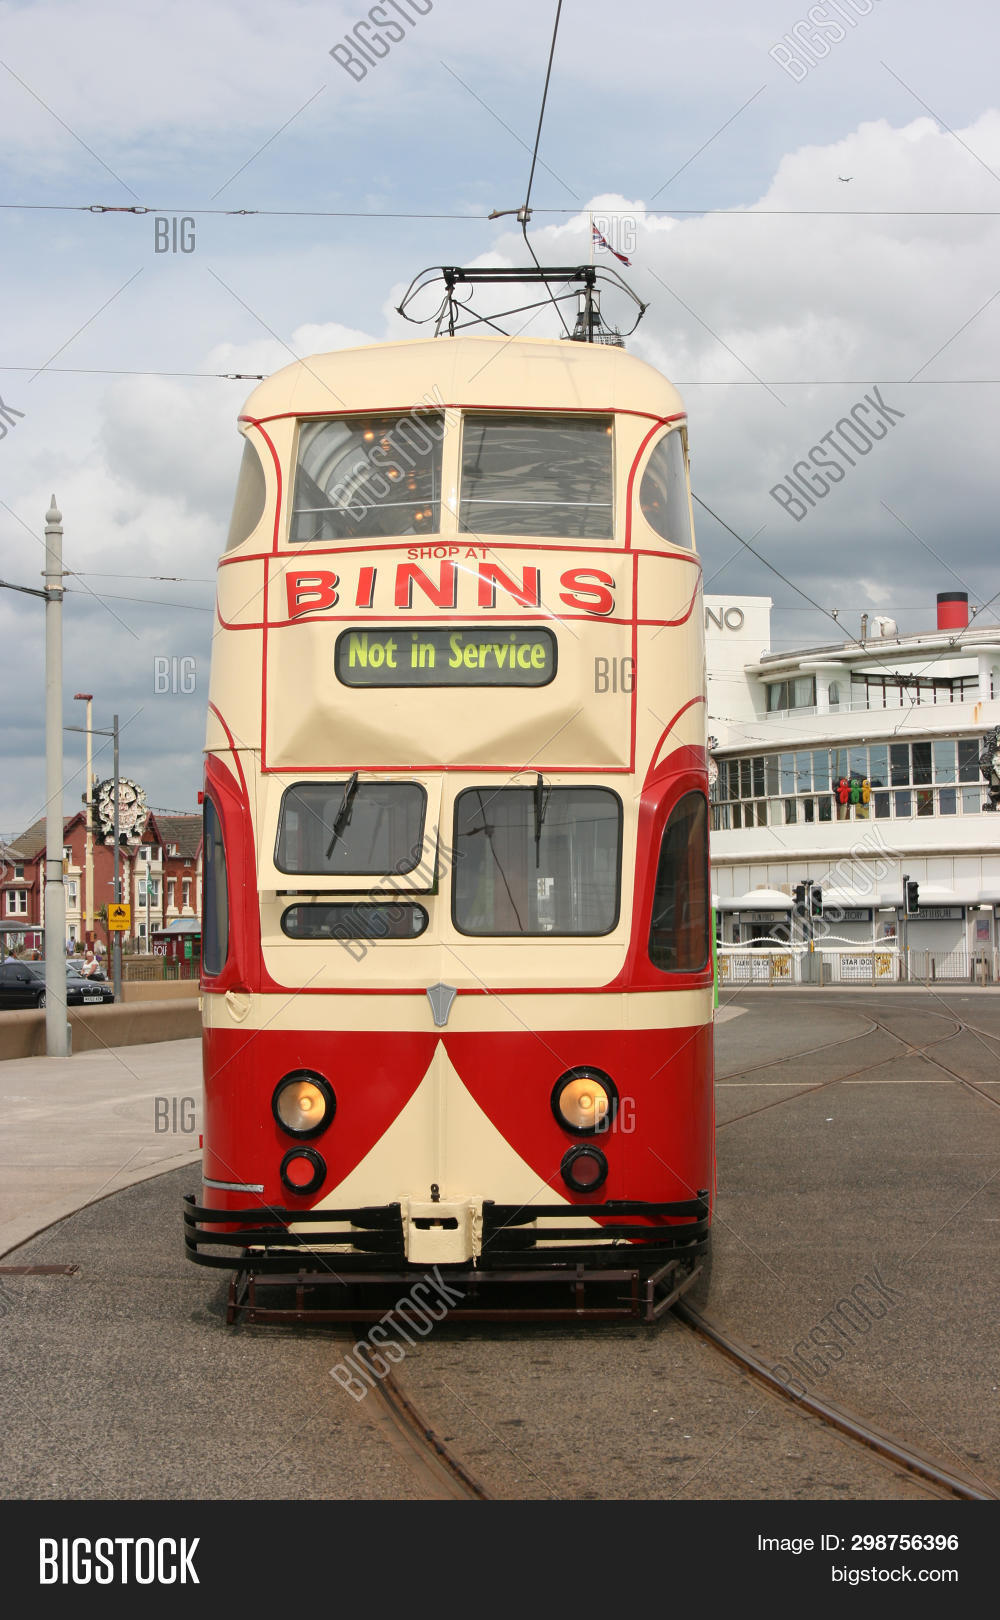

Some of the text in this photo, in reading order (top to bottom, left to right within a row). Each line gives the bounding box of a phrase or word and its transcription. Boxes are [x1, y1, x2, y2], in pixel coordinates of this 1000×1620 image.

[407, 546, 490, 560] SHOP AT
[285, 559, 615, 619] BINNS
[704, 606, 745, 631] NO
[349, 632, 546, 670] Not in Service
